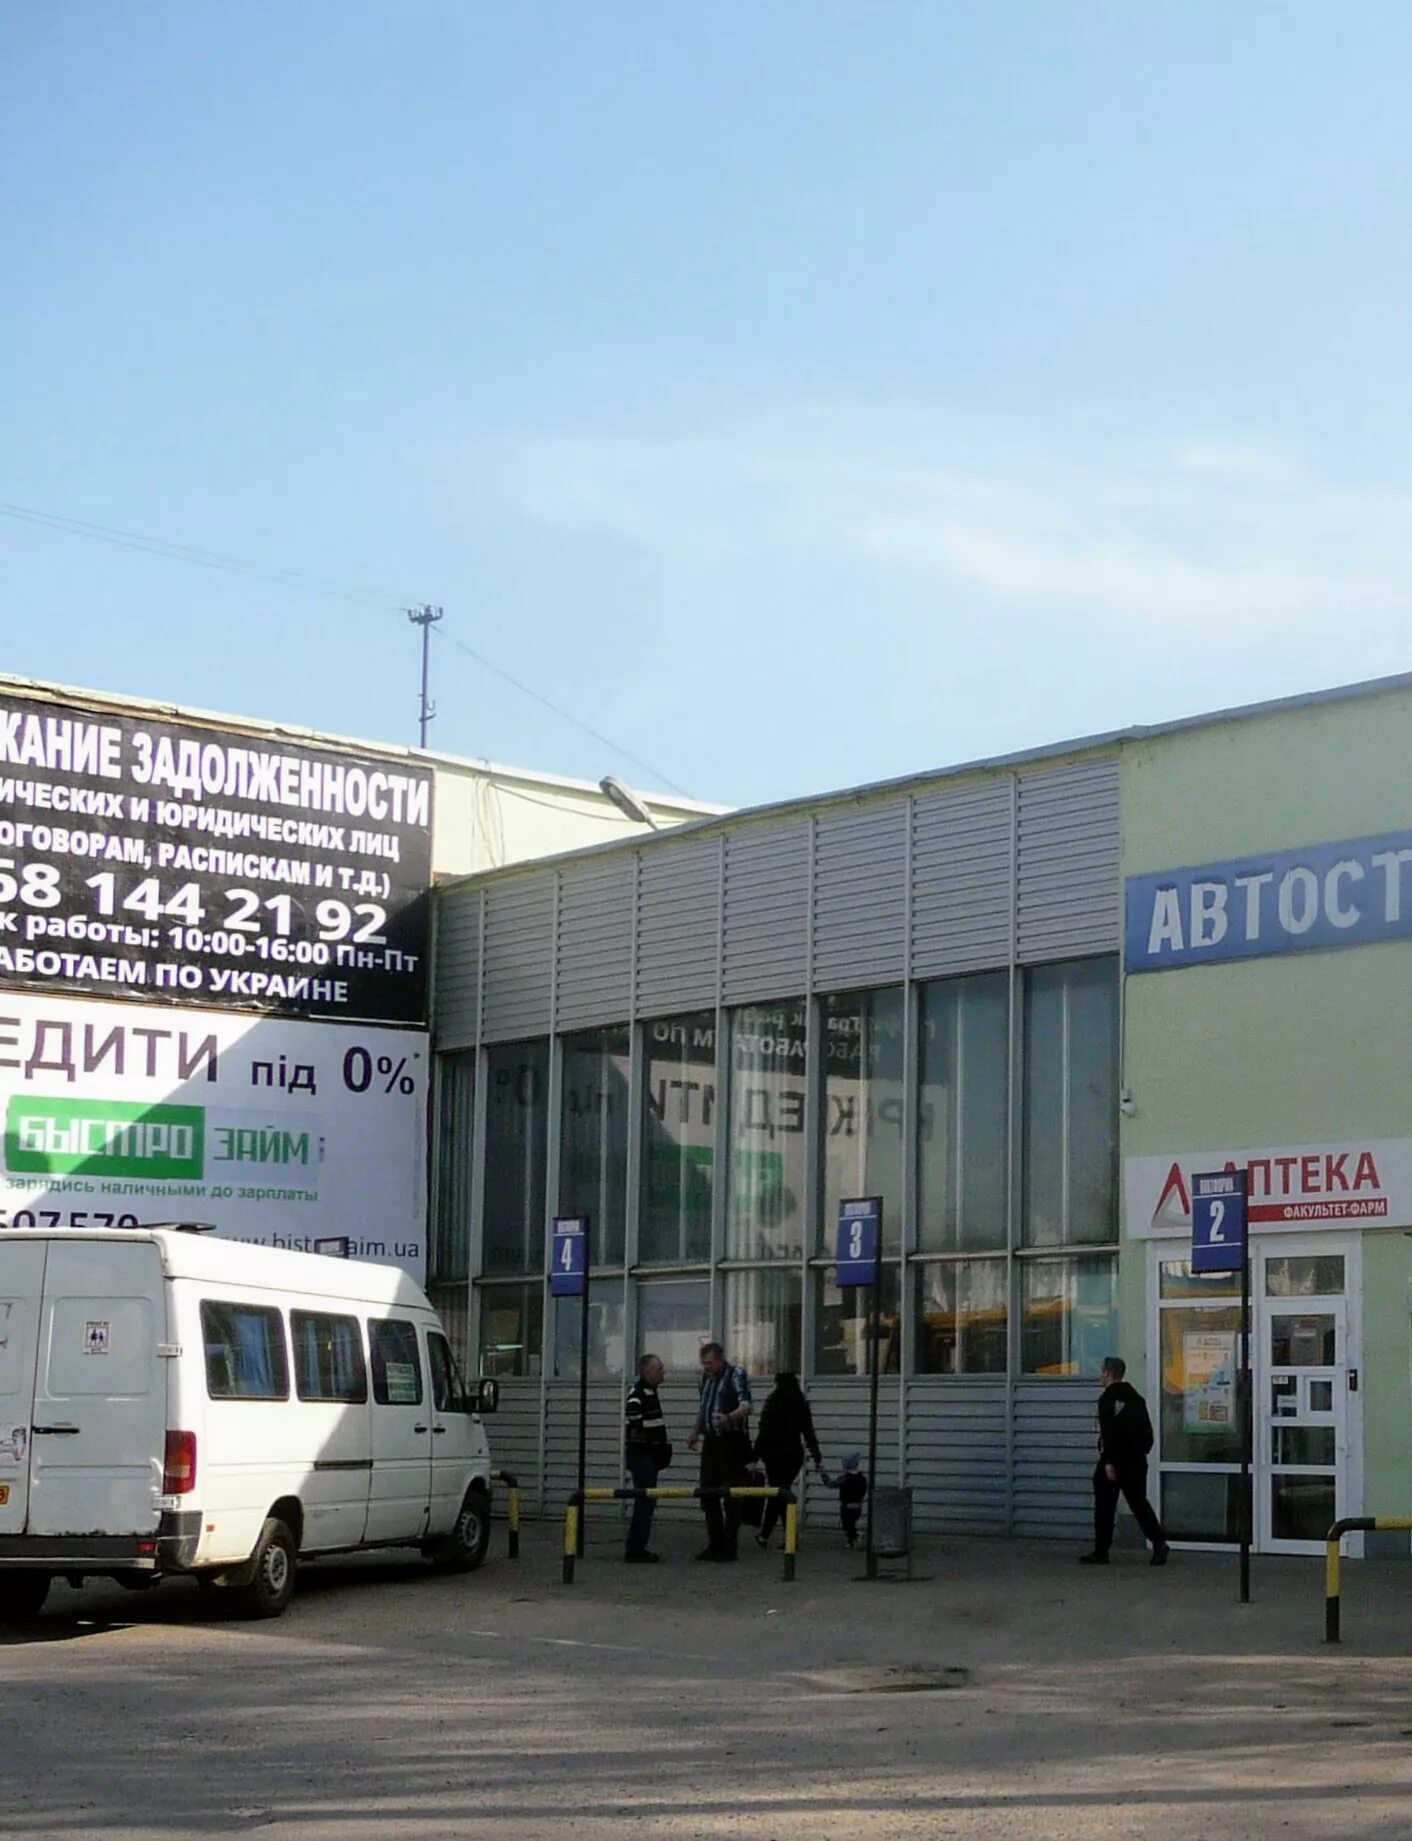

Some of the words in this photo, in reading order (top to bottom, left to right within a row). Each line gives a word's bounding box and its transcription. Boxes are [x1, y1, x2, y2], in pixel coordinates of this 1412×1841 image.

[131, 732, 429, 827] ЗАДОЛЖЕННОСТИ
[0, 777, 124, 819] ИЧЕСКИХ
[130, 797, 149, 823] И
[157, 801, 345, 851] ЮРИДИЧЕСКИХ
[349, 829, 400, 863] ЛИЦ
[159, 842, 310, 886] РАСПИСКАМ
[315, 863, 333, 888] И
[85, 872, 206, 926] 144
[223, 888, 291, 936] 21
[316, 899, 387, 945] 92
[26, 915, 160, 947] работы:
[168, 926, 329, 965] 10:00-16:00
[337, 945, 419, 972] Пн-Пт
[156, 963, 202, 990] ПО
[209, 968, 348, 1002] УКРАИНЕ
[252, 1055, 316, 1095] під
[19, 1115, 193, 1160] БЫСТРО
[213, 1125, 309, 1165] ЗАЙМ
[6, 1178, 95, 1194] зарядись
[101, 1183, 206, 1198] наличными
[211, 1186, 233, 1199] до
[238, 1187, 318, 1202] зарплаты
[1224, 1151, 1381, 1196] ПТЕКА
[1209, 1200, 1225, 1242] 2
[1284, 1201, 1385, 1218] ФАКУЛЬТЕТ-ФАРМ
[561, 1238, 573, 1271] 4
[849, 1221, 862, 1258] 3
